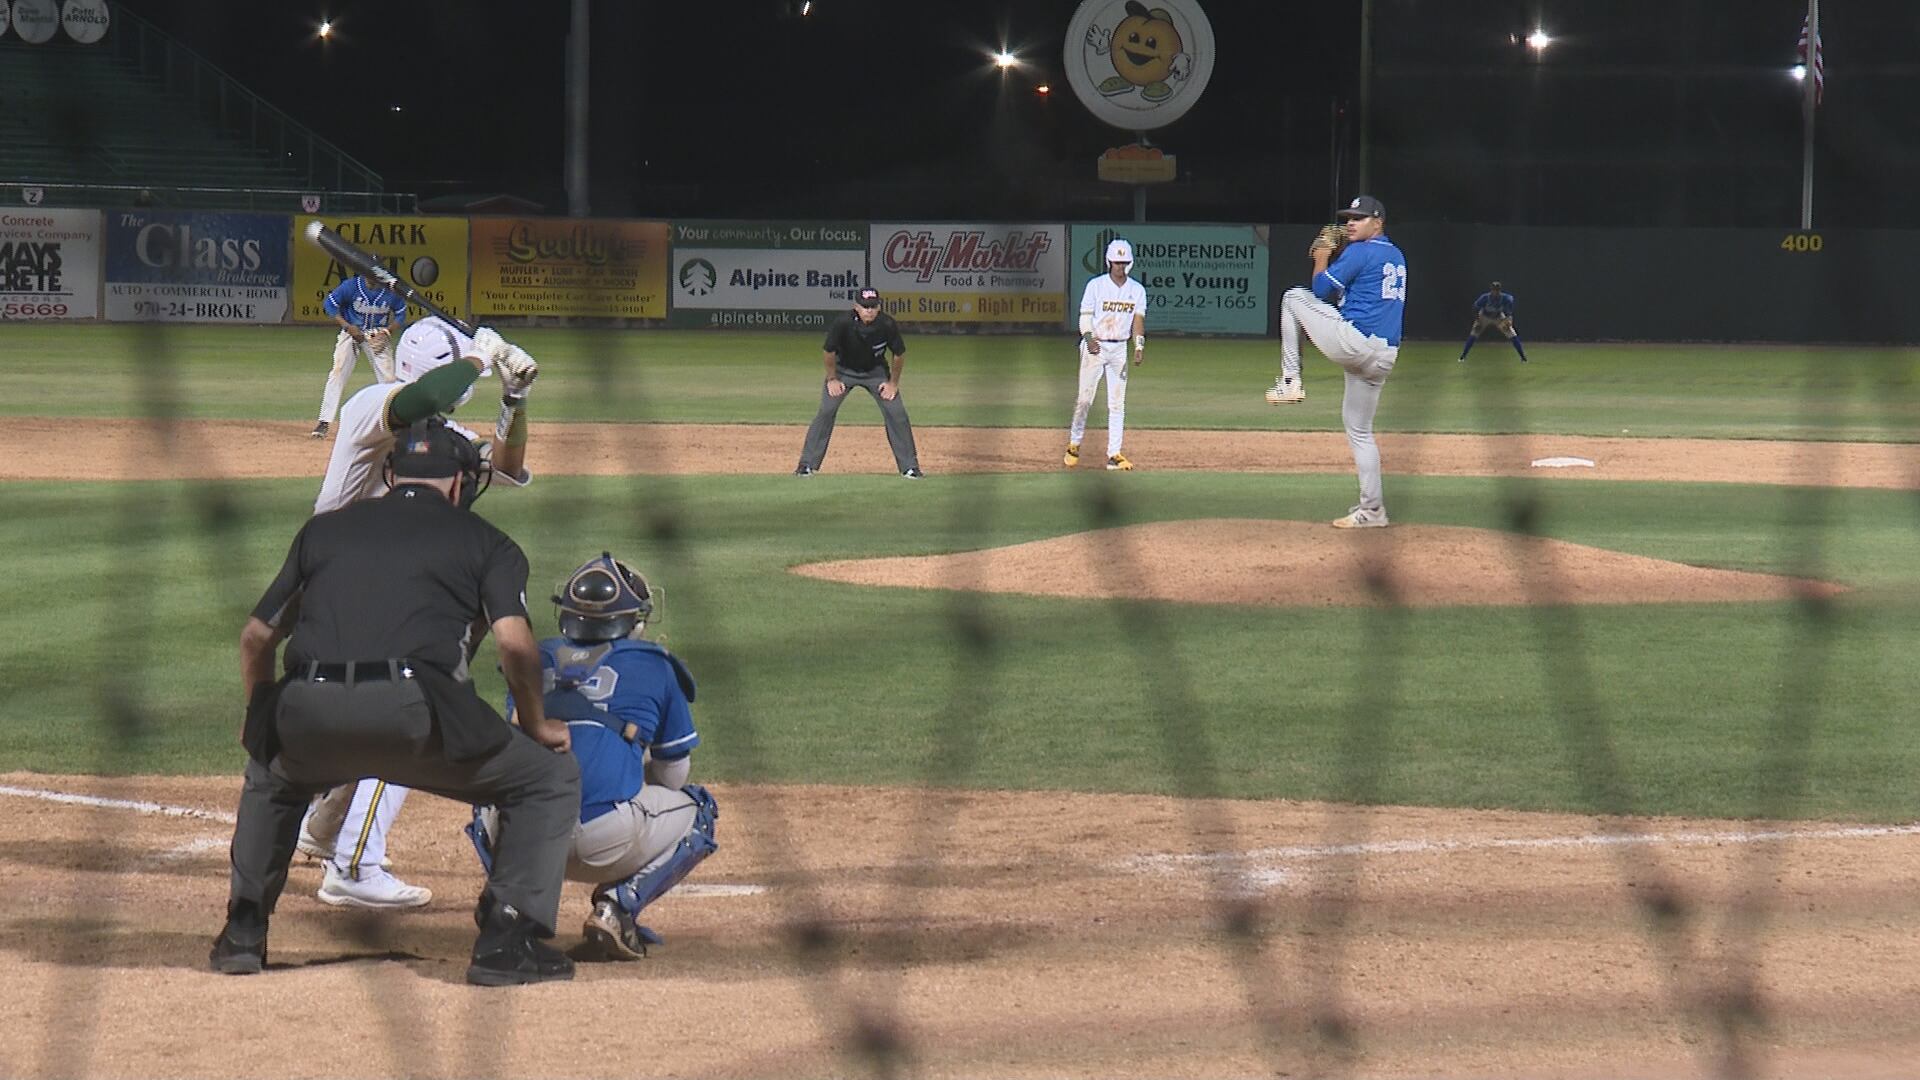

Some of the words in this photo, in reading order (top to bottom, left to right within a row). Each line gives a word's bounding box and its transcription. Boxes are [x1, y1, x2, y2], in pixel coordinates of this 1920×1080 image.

[64, 13, 108, 24] ARNOLD
[2, 215, 54, 226] Concrete
[120, 213, 144, 227] The
[37, 230, 91, 241] Company
[336, 223, 427, 245] CLARK
[678, 226, 709, 240] Your
[790, 228, 817, 240] Our
[820, 227, 862, 241] focus.
[136, 223, 262, 271] Glass
[1781, 235, 1823, 252] 400
[883, 230, 942, 283] City
[937, 231, 1051, 273] Market
[1135, 244, 1257, 259] INDEPENDENT
[1135, 260, 1175, 269] Wealth
[1179, 261, 1254, 272] Management
[216, 271, 281, 285] Brokerage
[500, 277, 533, 286] BRAKES
[729, 269, 800, 290] Alpine
[806, 270, 859, 288] Bank
[944, 275, 973, 286] Food
[977, 276, 986, 286] &
[990, 276, 1045, 289] Pharmacy
[1142, 272, 1176, 288] Lee
[1182, 273, 1249, 294] Young
[1381, 262, 1407, 301] 23
[111, 286, 142, 296] AUTO
[153, 286, 235, 298] COMMERCIAL
[246, 289, 280, 299] HOME
[918, 298, 961, 314] Store.
[978, 299, 1015, 315] Right
[1022, 299, 1062, 314] Price.
[1102, 300, 1136, 314] GATORS
[711, 312, 825, 326] alpinebank.com
